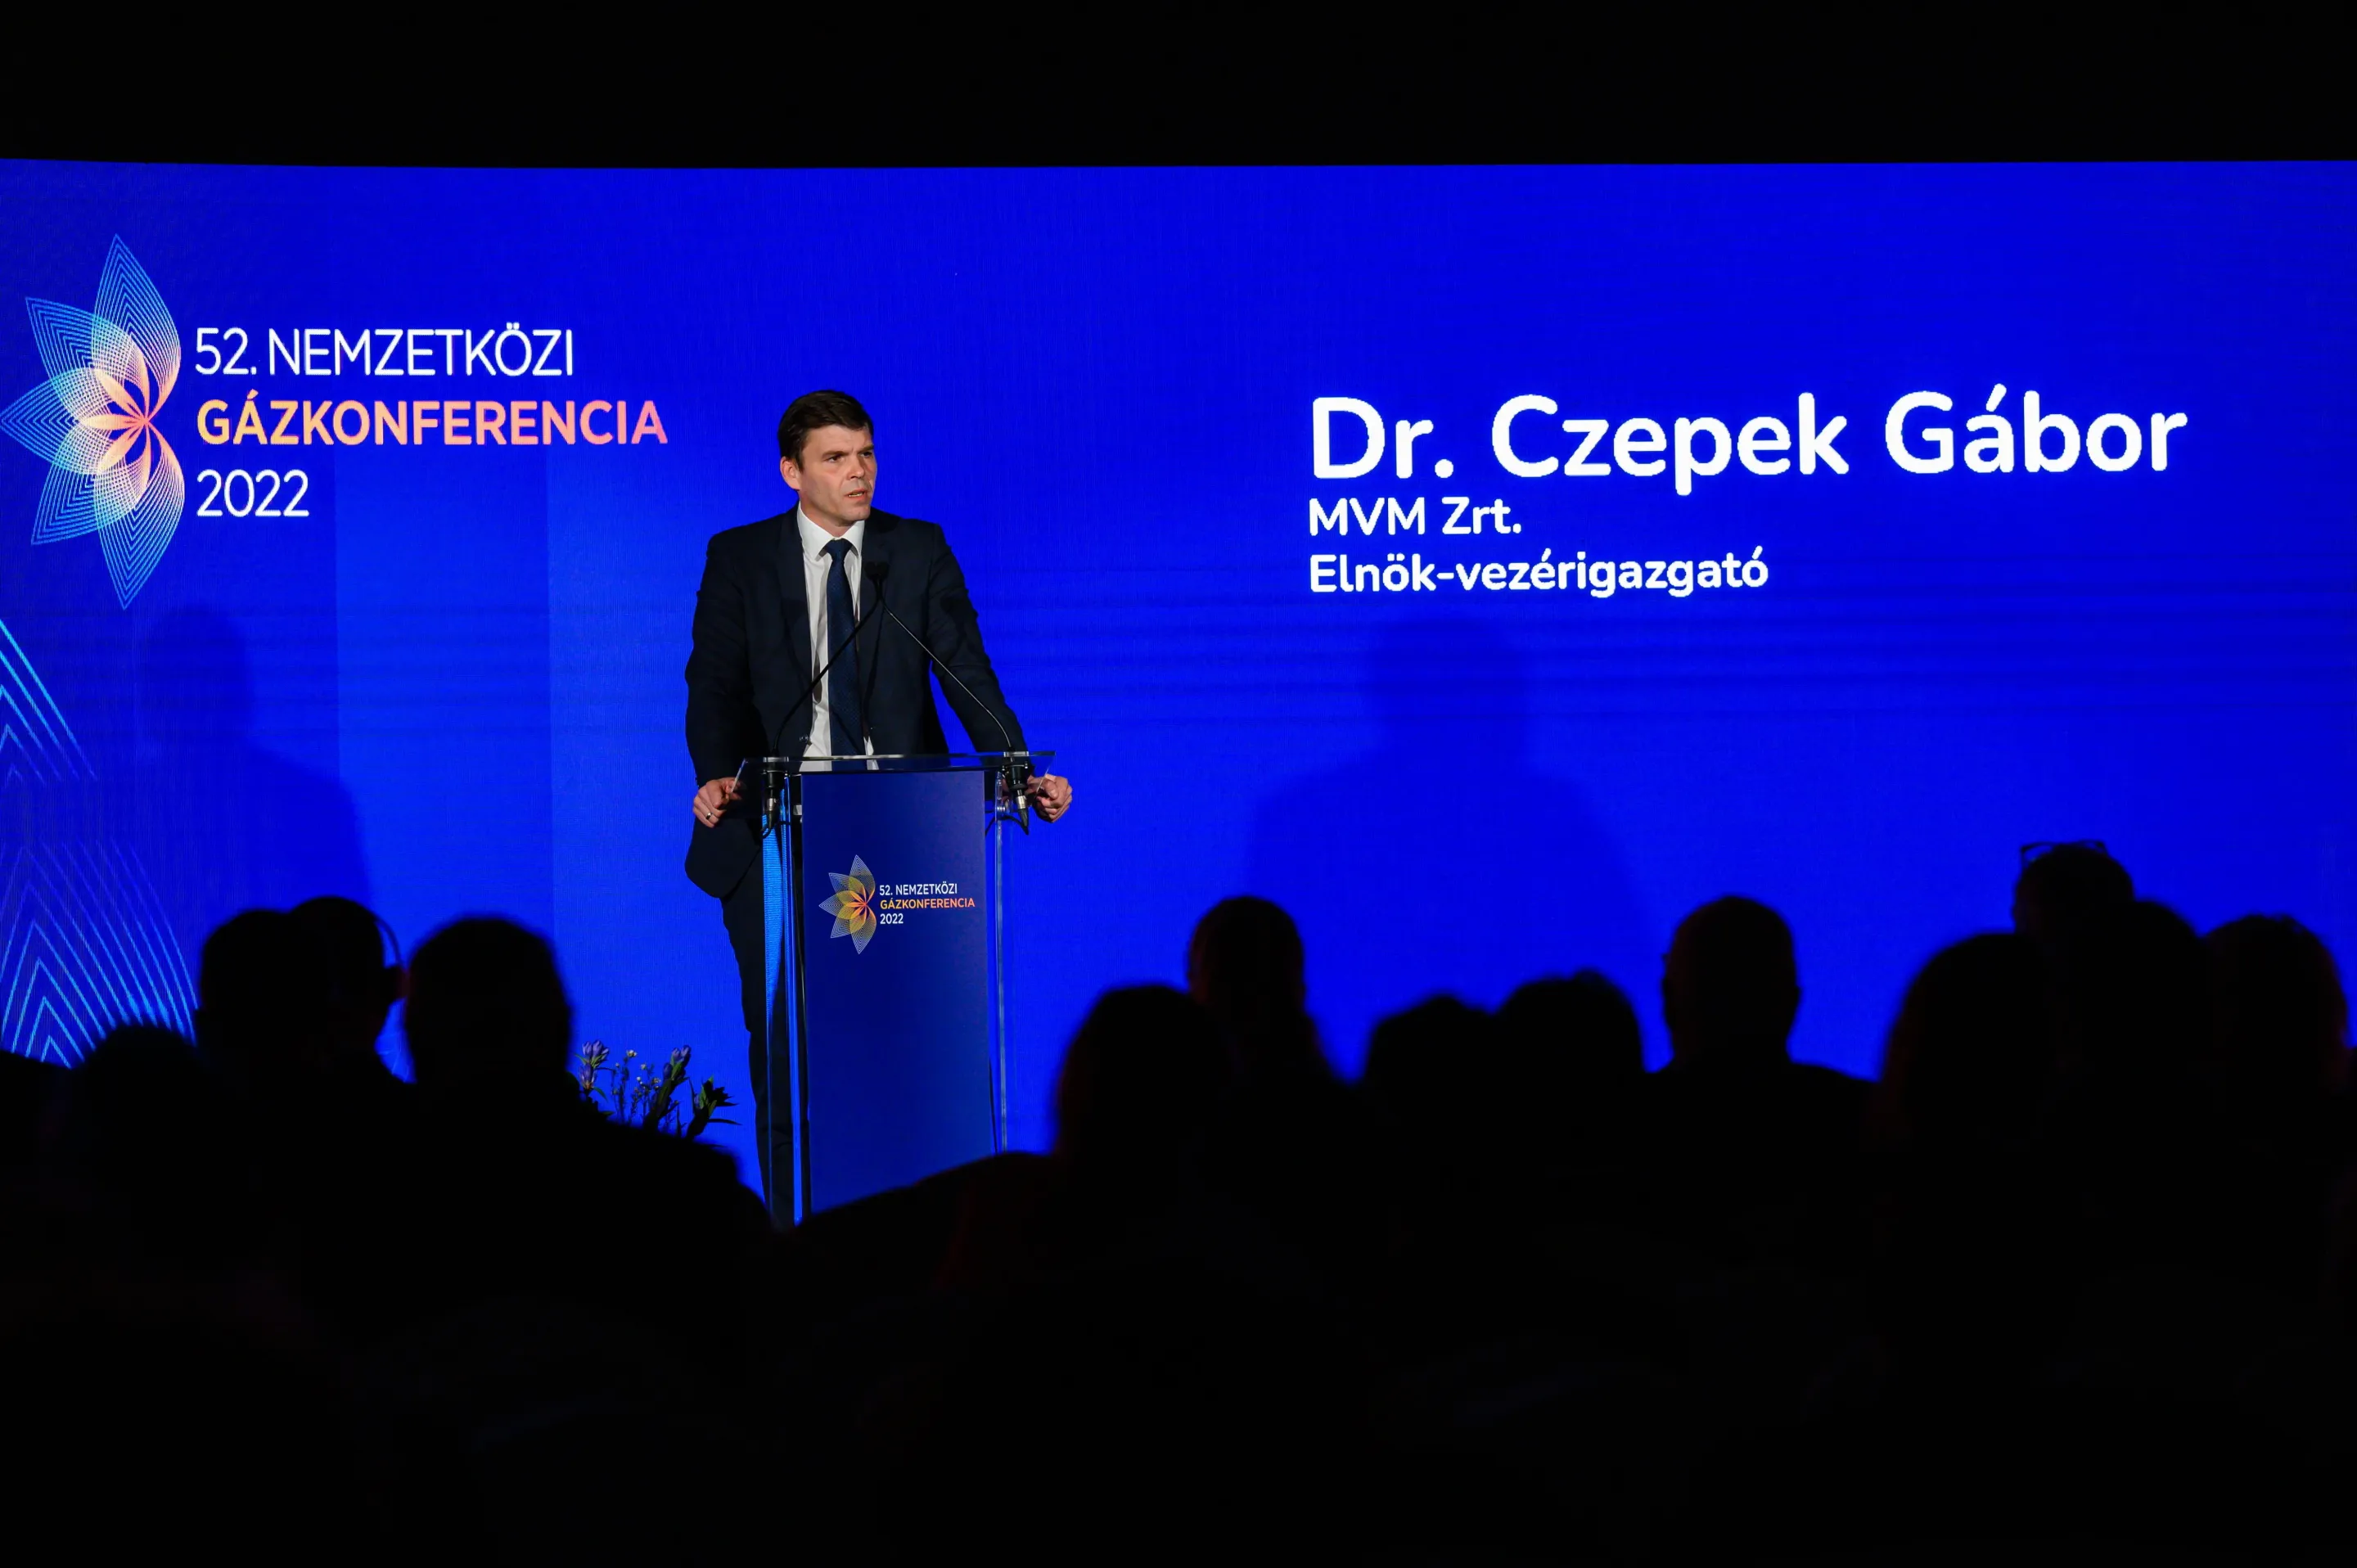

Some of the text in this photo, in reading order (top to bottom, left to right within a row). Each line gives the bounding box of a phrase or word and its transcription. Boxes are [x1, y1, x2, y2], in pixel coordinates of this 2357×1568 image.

[195, 322, 573, 376] 52. NEMZETKÖZI
[197, 388, 668, 445] GÁZKONFERENCIA
[1312, 383, 2188, 496] Dr. Czepek Gábor
[196, 469, 309, 517] 2022
[1309, 496, 1521, 536] MVM Zrt.
[1309, 546, 1769, 598] Elnök-vezérigazgató
[879, 881, 958, 896] 52. NEMZETKÖZI
[880, 897, 976, 910] GÁZKONFERENCIA
[880, 913, 904, 925] 2022
